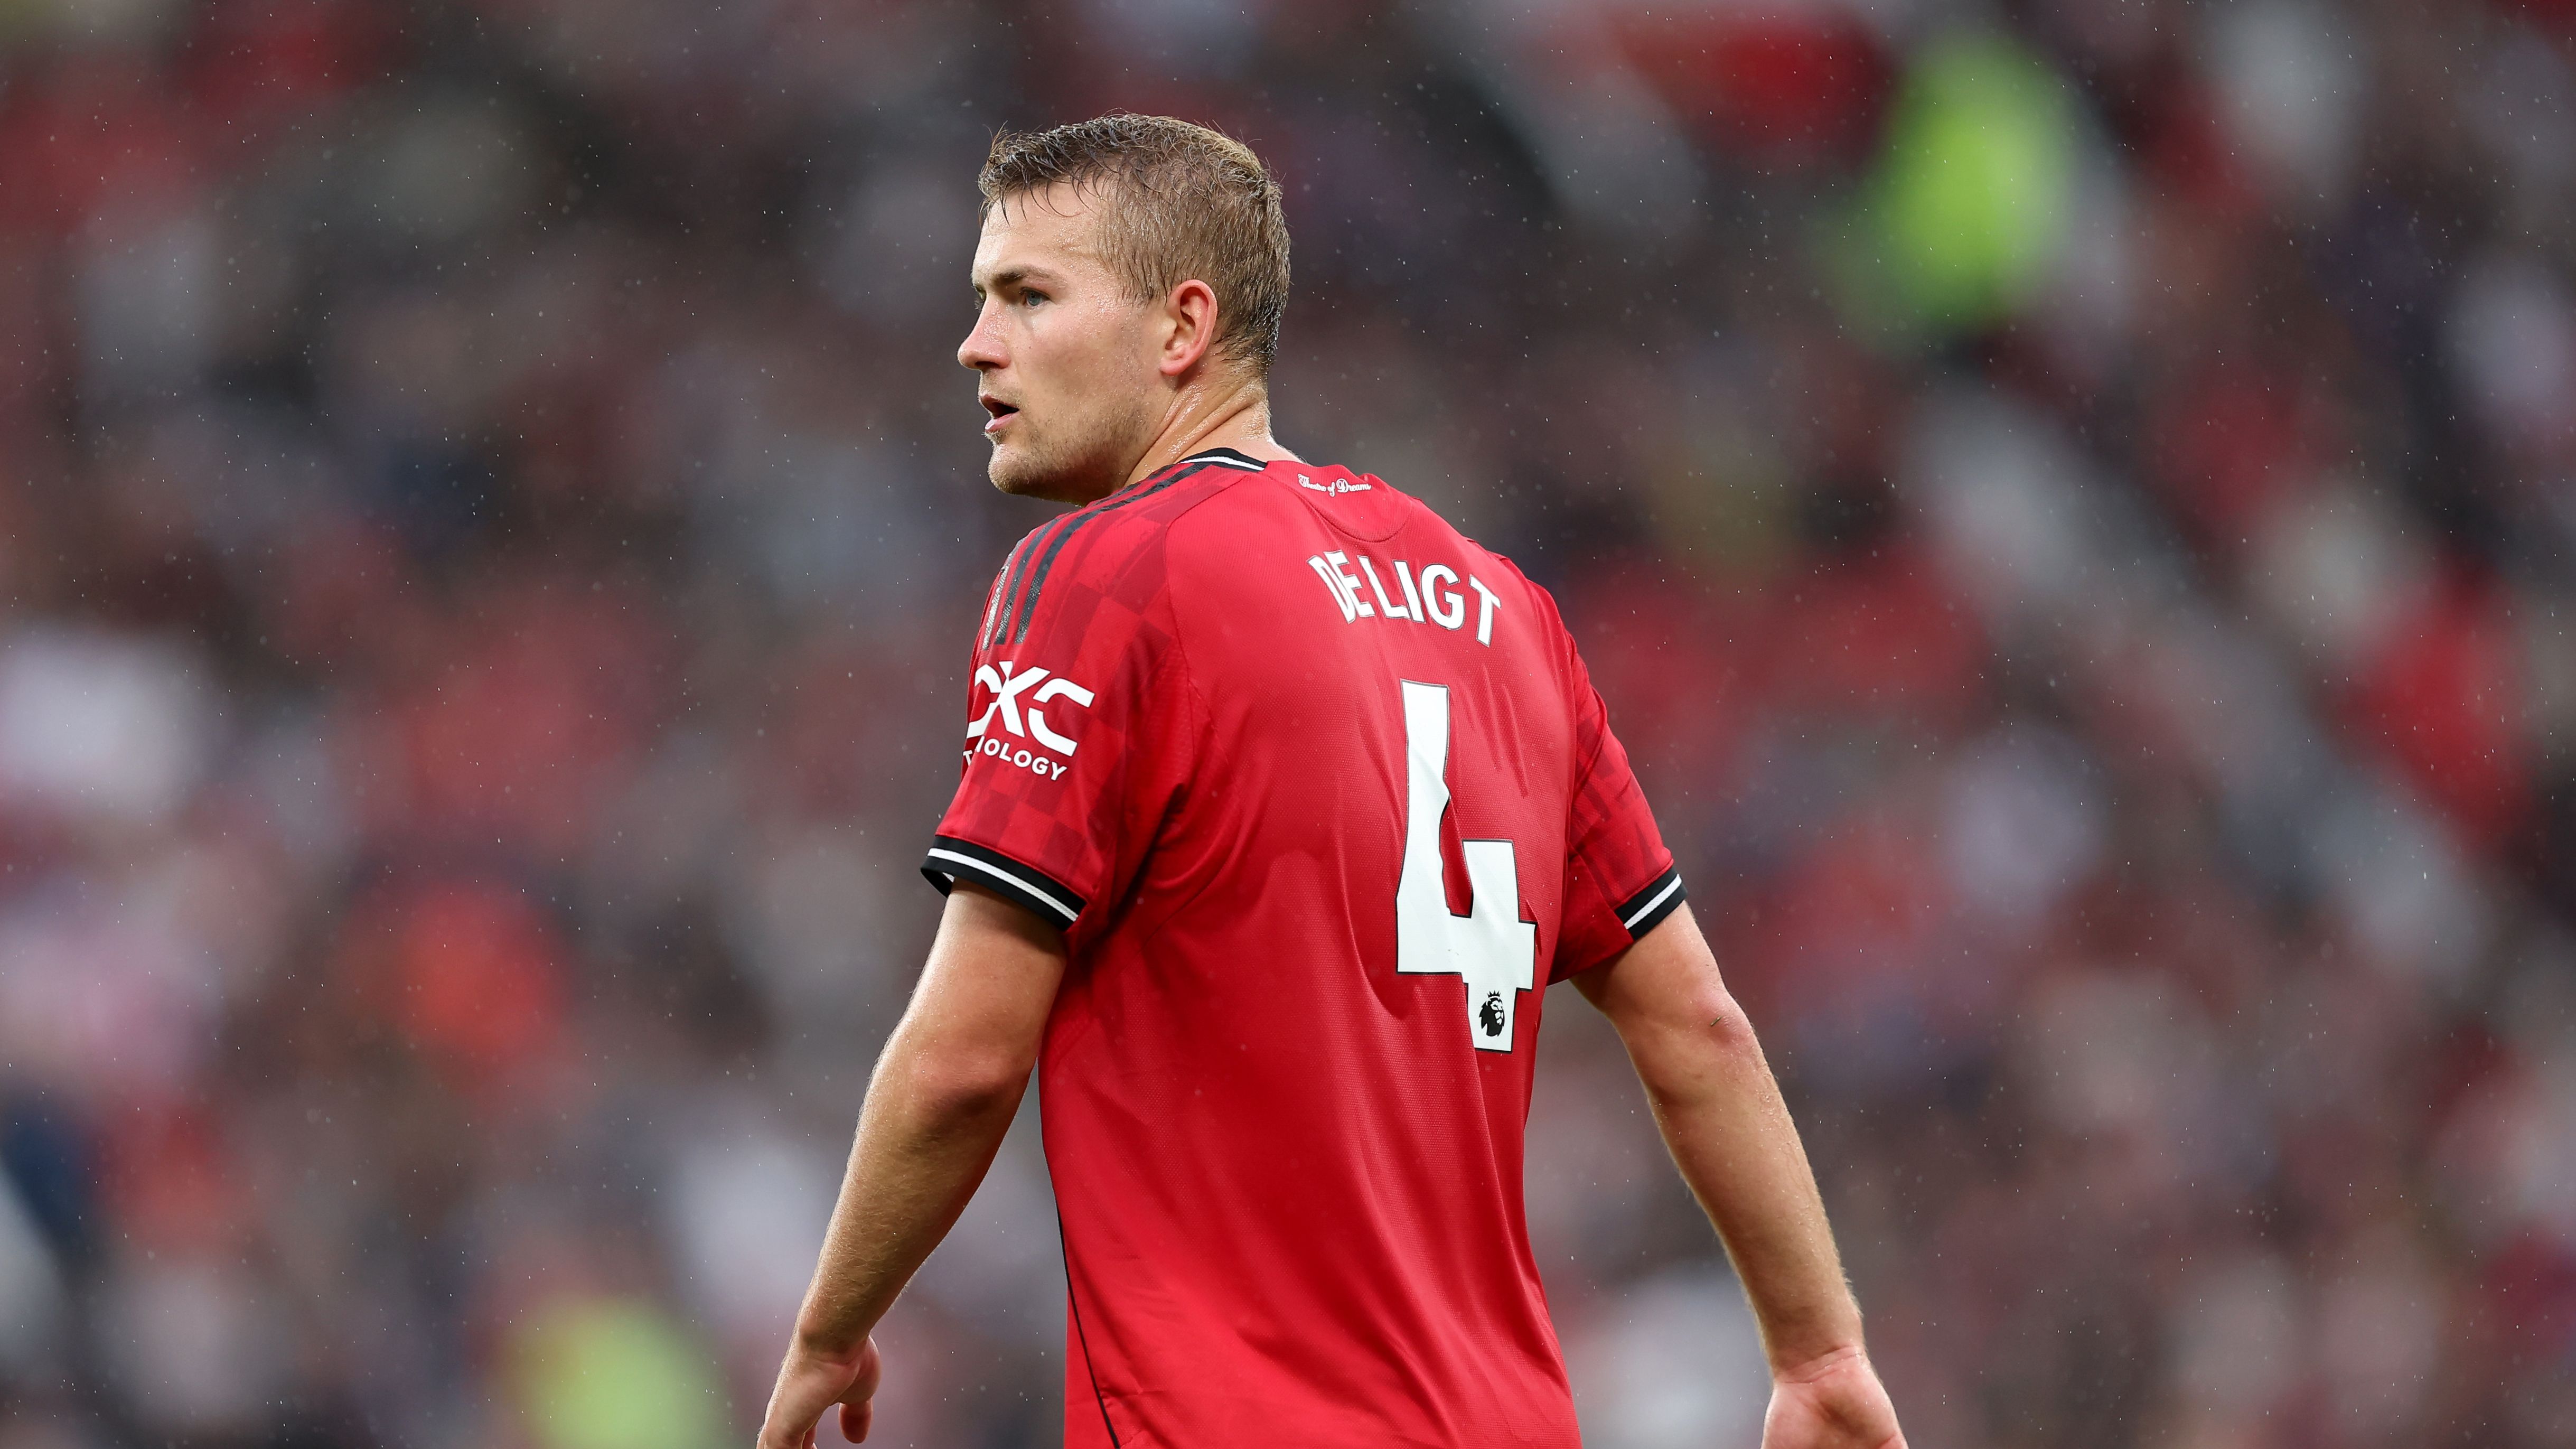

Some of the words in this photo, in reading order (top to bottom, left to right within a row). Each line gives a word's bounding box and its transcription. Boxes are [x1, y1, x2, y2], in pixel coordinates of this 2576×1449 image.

[1298, 473, 1327, 492] Theatre
[1327, 482, 1335, 497] of
[1336, 478, 1372, 493] Dreams
[1395, 679, 1536, 1053] 4
